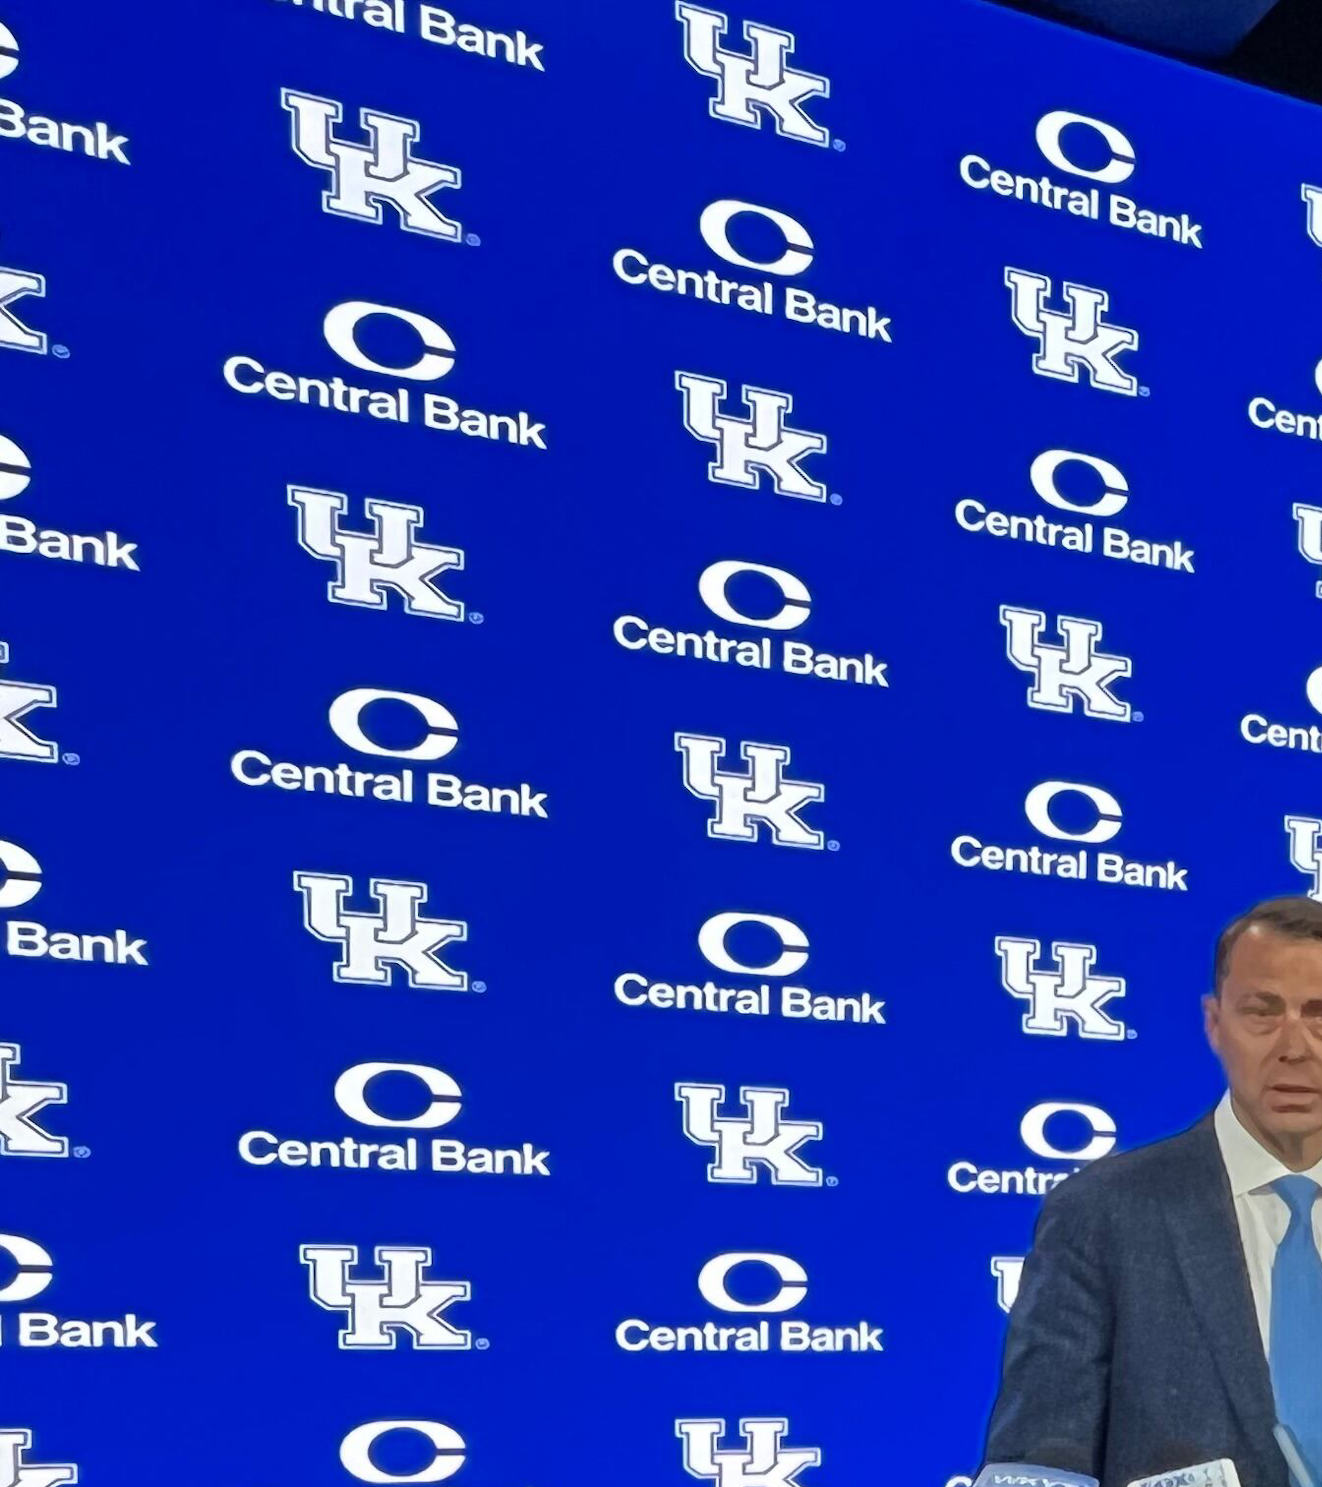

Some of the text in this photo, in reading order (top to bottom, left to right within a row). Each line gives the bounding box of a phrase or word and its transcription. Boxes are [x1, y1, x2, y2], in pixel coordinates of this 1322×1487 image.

[420, 4, 545, 72] Bank
[959, 154, 1203, 249] Central Bank
[612, 248, 892, 343] Central Bank
[223, 355, 547, 450] Central Bank
[0, 514, 140, 572] Bank
[954, 498, 1195, 574] Central Bank
[613, 614, 889, 688] Central Bank
[230, 749, 548, 819] Central Bank
[950, 835, 1188, 891] Central Bank
[6, 920, 149, 966] Bank
[613, 972, 886, 1025] Central Bank
[238, 1130, 551, 1176] Central Bank
[947, 1161, 1081, 1196] Centr
[18, 1312, 158, 1348] Bank
[615, 1318, 884, 1352] Central Bank
